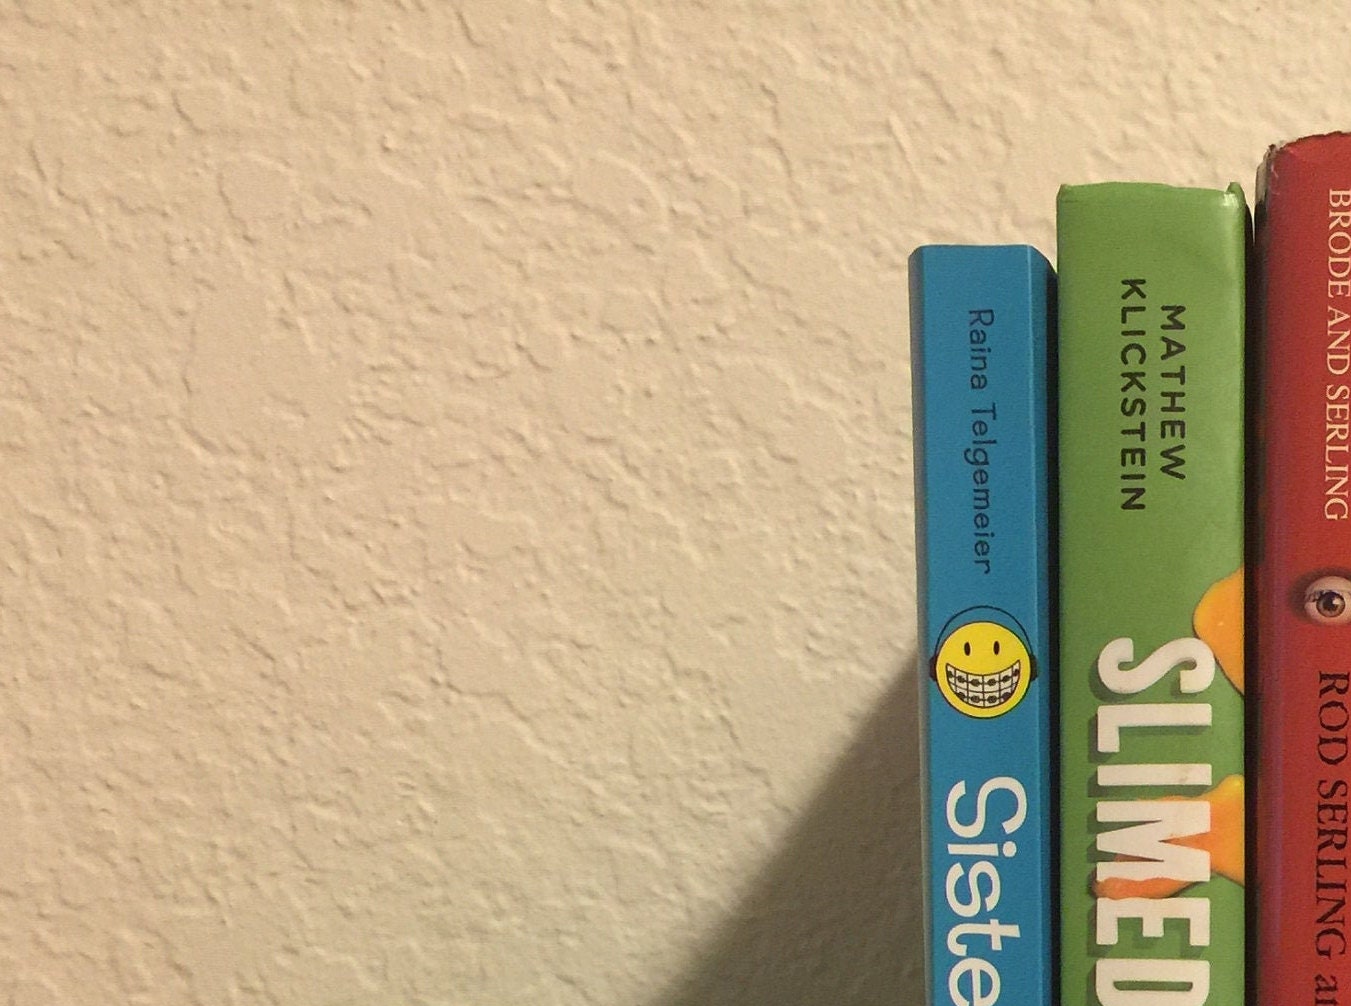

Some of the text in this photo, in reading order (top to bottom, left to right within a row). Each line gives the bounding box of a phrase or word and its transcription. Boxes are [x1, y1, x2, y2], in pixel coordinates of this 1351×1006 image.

[1120, 278, 1147, 511] KLICKSTEIN
[1160, 304, 1187, 481] MATHEW
[1326, 306, 1351, 375] AND
[964, 308, 996, 575] Raina Telgemeier
[1324, 386, 1350, 521] SERLING
[1317, 671, 1350, 766] ROD
[1314, 779, 1349, 960] SERLING
